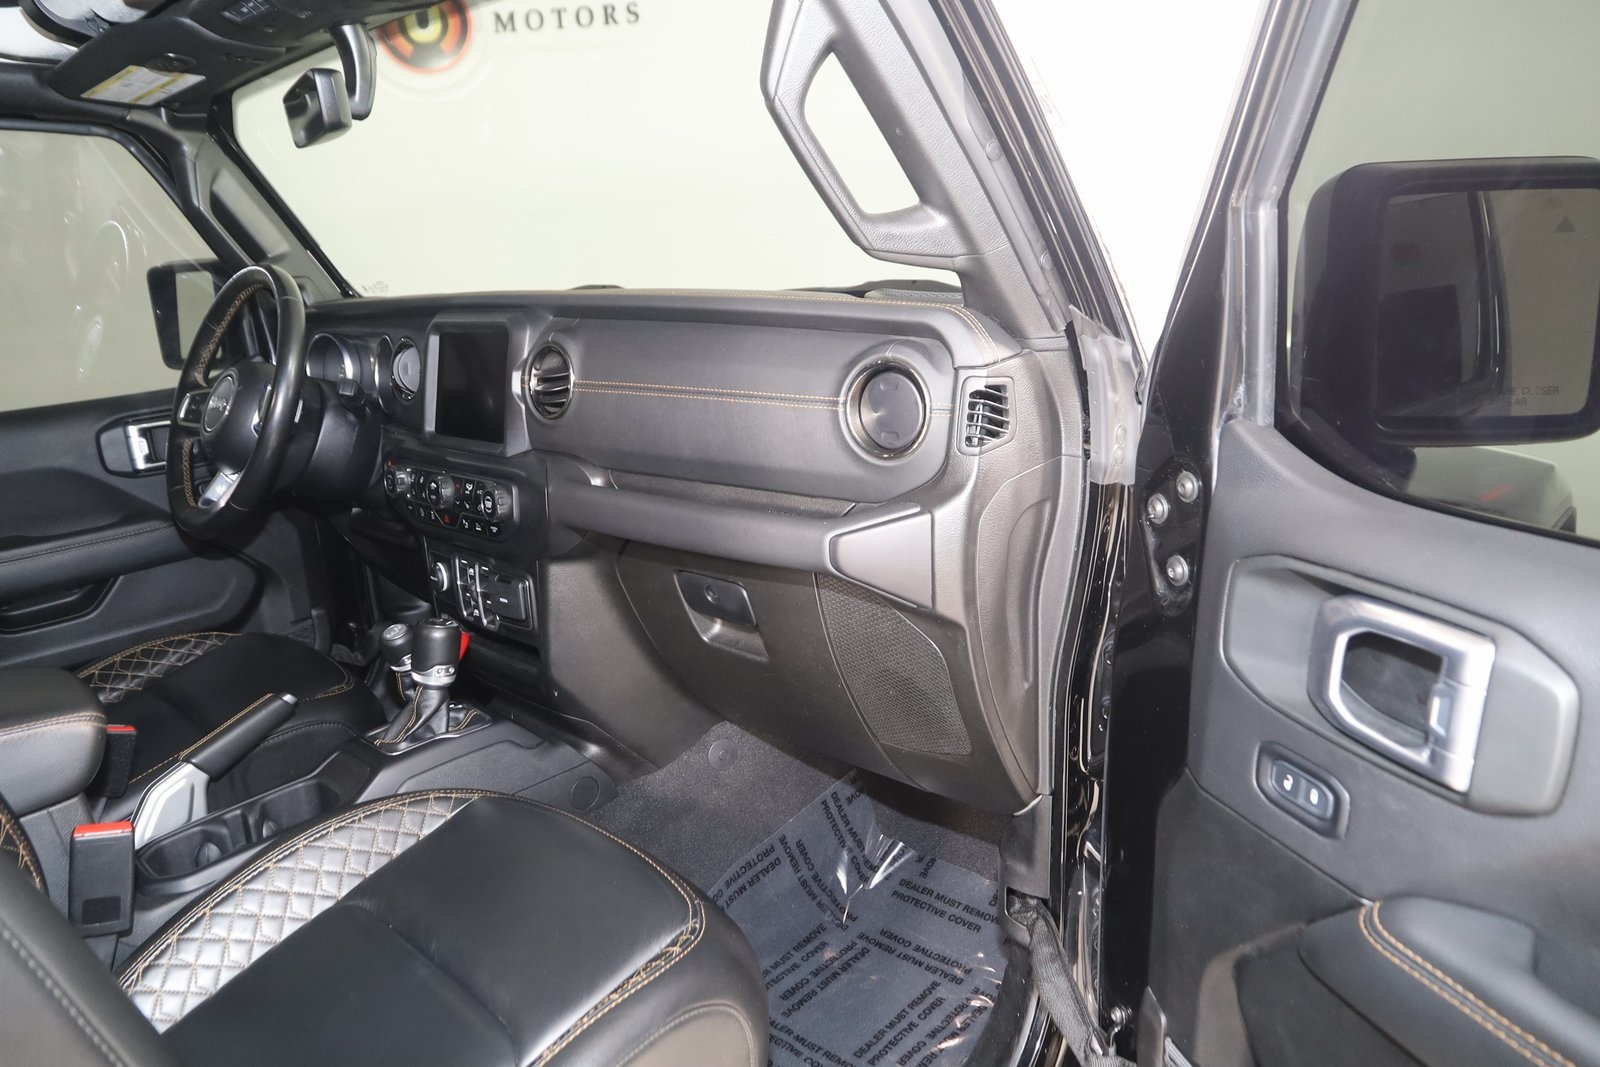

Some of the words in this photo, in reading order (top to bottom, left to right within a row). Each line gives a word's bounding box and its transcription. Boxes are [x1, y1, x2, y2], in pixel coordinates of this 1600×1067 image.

[493, 2, 640, 34] MOTORS
[831, 791, 852, 828] DEALER
[847, 827, 866, 855] MUST
[724, 844, 776, 890] PROTECTIVE
[779, 834, 801, 875] REMOVE
[795, 839, 815, 871] COVER
[748, 857, 782, 888] DEALER
[725, 885, 748, 908] MUST
[797, 875, 819, 901] MUST
[899, 878, 935, 897] DEALER
[934, 893, 963, 909] MUST
[891, 890, 947, 919] PROTECTIVE
[948, 914, 982, 933] COVER
[769, 951, 795, 971] MUST
[793, 923, 828, 953] REMOVE
[801, 941, 830, 962] COVER
[856, 932, 897, 955] REMOVE
[879, 928, 912, 948] COVER
[838, 946, 871, 973] DEALER
[897, 951, 926, 969] MUST
[913, 943, 974, 975] PROTECTIVE
[925, 961, 964, 985] DEALER
[780, 977, 810, 1001] COVER
[817, 970, 841, 991] MUST
[781, 989, 818, 1018] REMOVE
[853, 1029, 888, 1059] DEALER
[885, 1008, 910, 1030] MUST
[907, 980, 941, 1011] REMOVE
[867, 1020, 919, 1066] PROTECTIVE
[918, 996, 946, 1021] COVER
[793, 1034, 823, 1054] MUST
[896, 1040, 927, 1067] COVER
